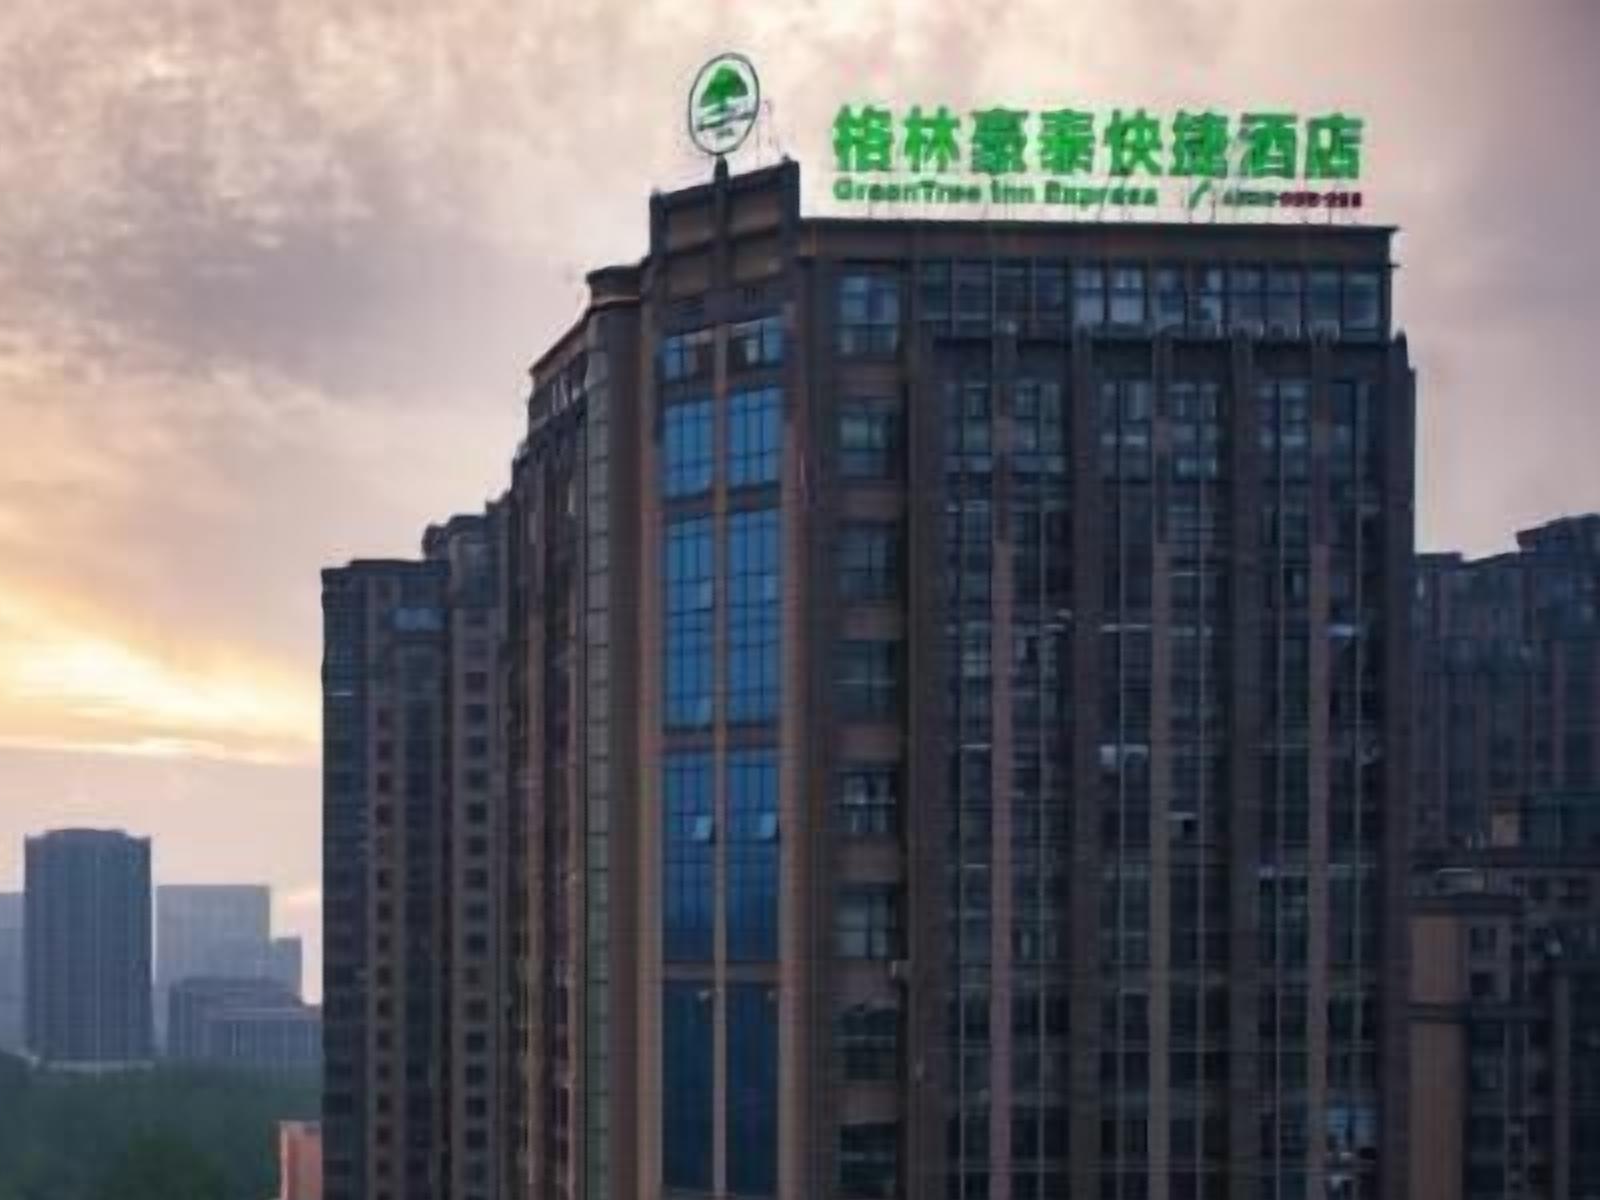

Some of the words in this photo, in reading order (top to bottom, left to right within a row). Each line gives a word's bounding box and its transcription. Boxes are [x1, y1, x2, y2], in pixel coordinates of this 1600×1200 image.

[833, 105, 1364, 178] 格林豪泰快捷酒店
